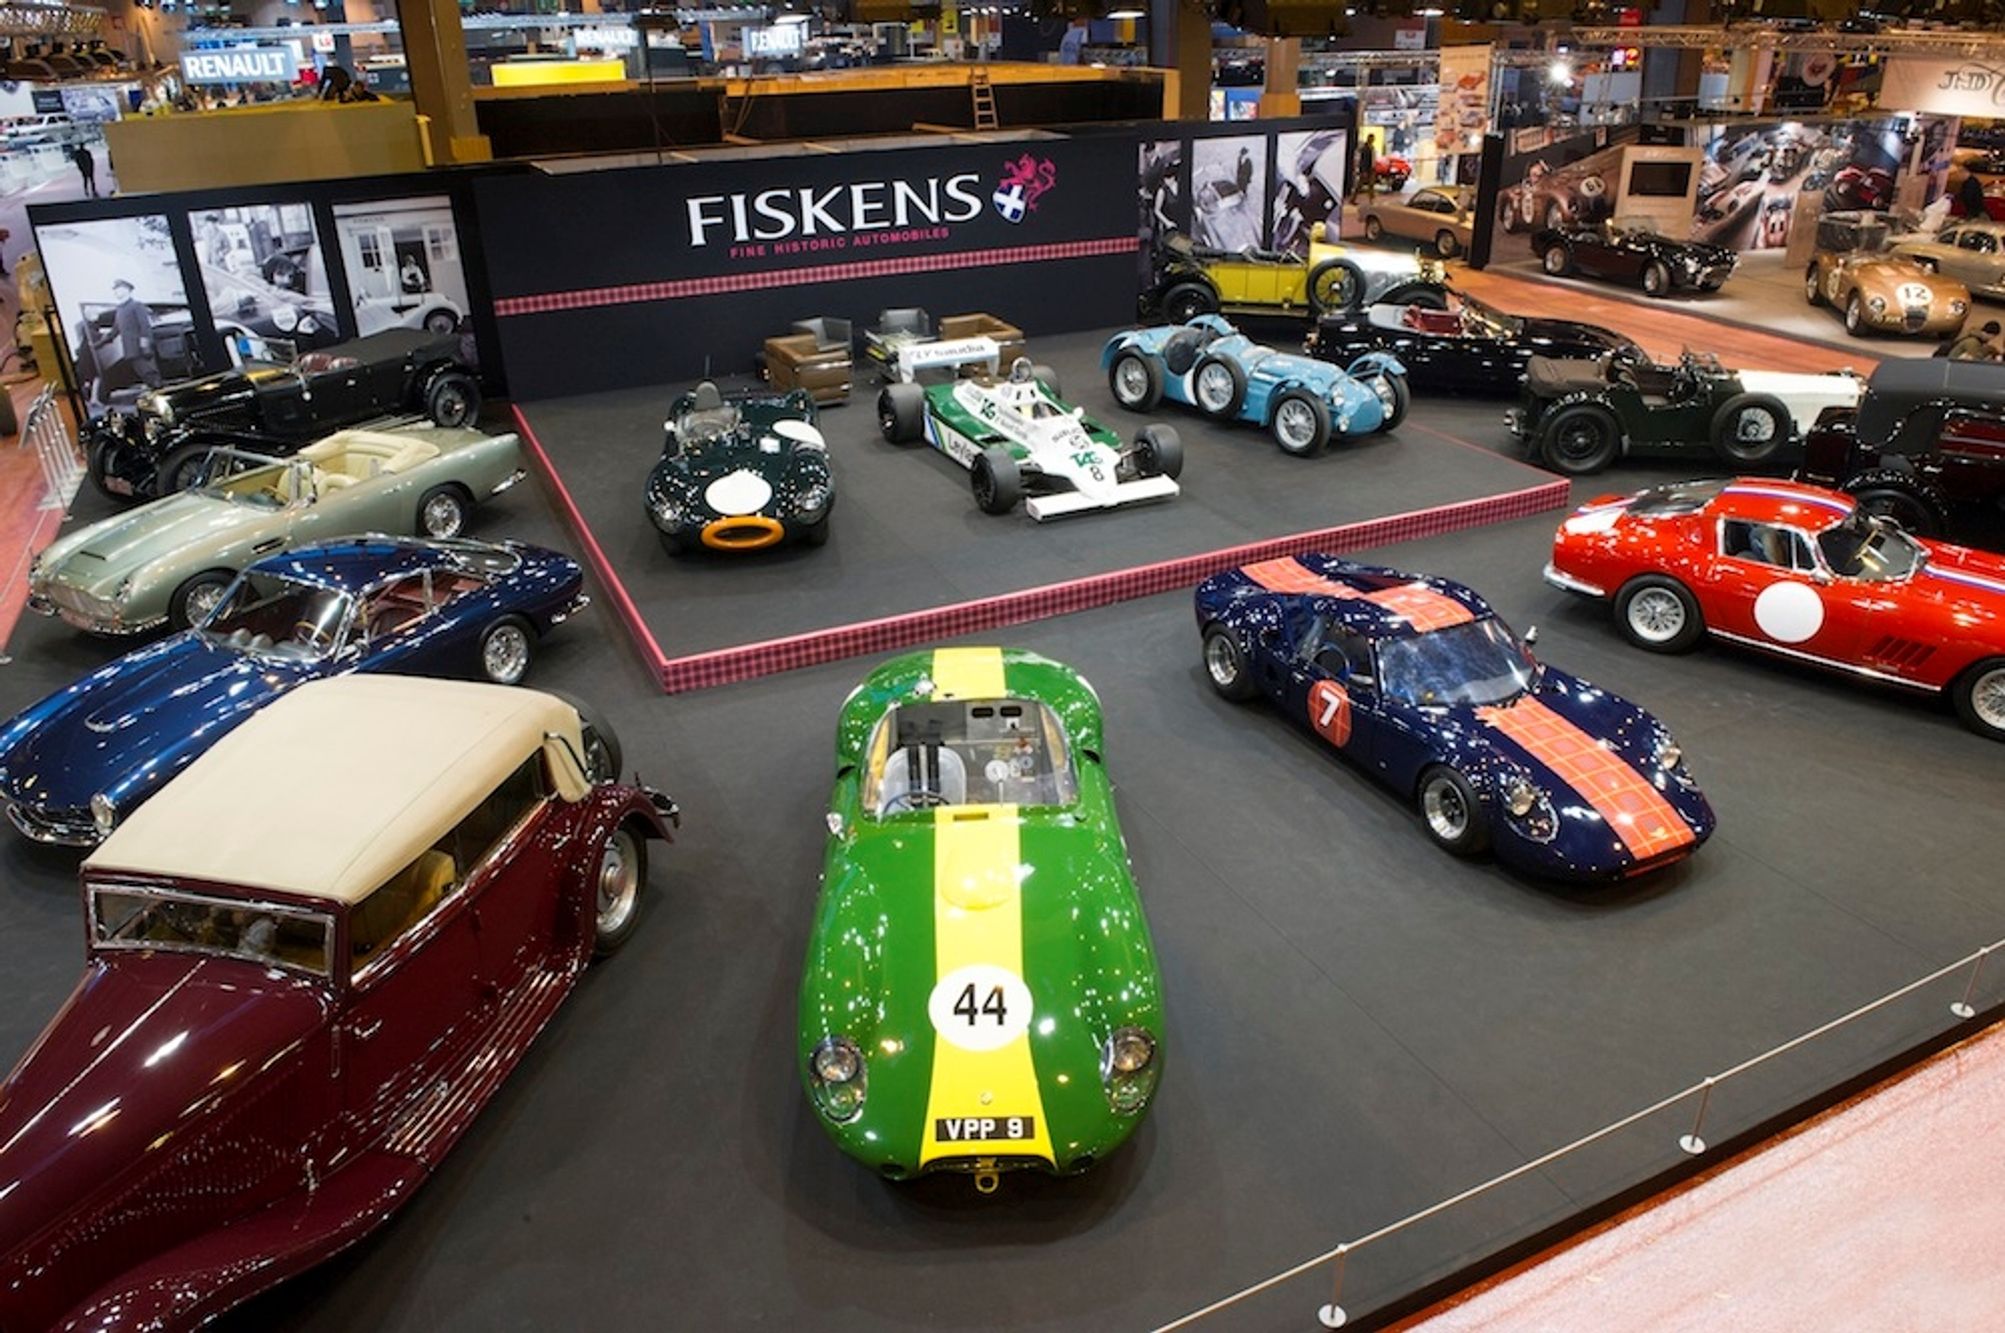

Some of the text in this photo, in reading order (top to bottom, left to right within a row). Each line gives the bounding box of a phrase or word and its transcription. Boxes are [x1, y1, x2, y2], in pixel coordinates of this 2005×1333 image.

[184, 53, 286, 79] RENAULT
[686, 173, 983, 246] FISKENS
[729, 226, 949, 259] FINE HISTORIC AUTOMOBILES
[1904, 286, 1928, 299] 12
[1090, 465, 1105, 482] 8
[1320, 688, 1341, 727] 7
[953, 982, 1008, 1027] 44
[945, 1117, 1024, 1140] VPP 9
